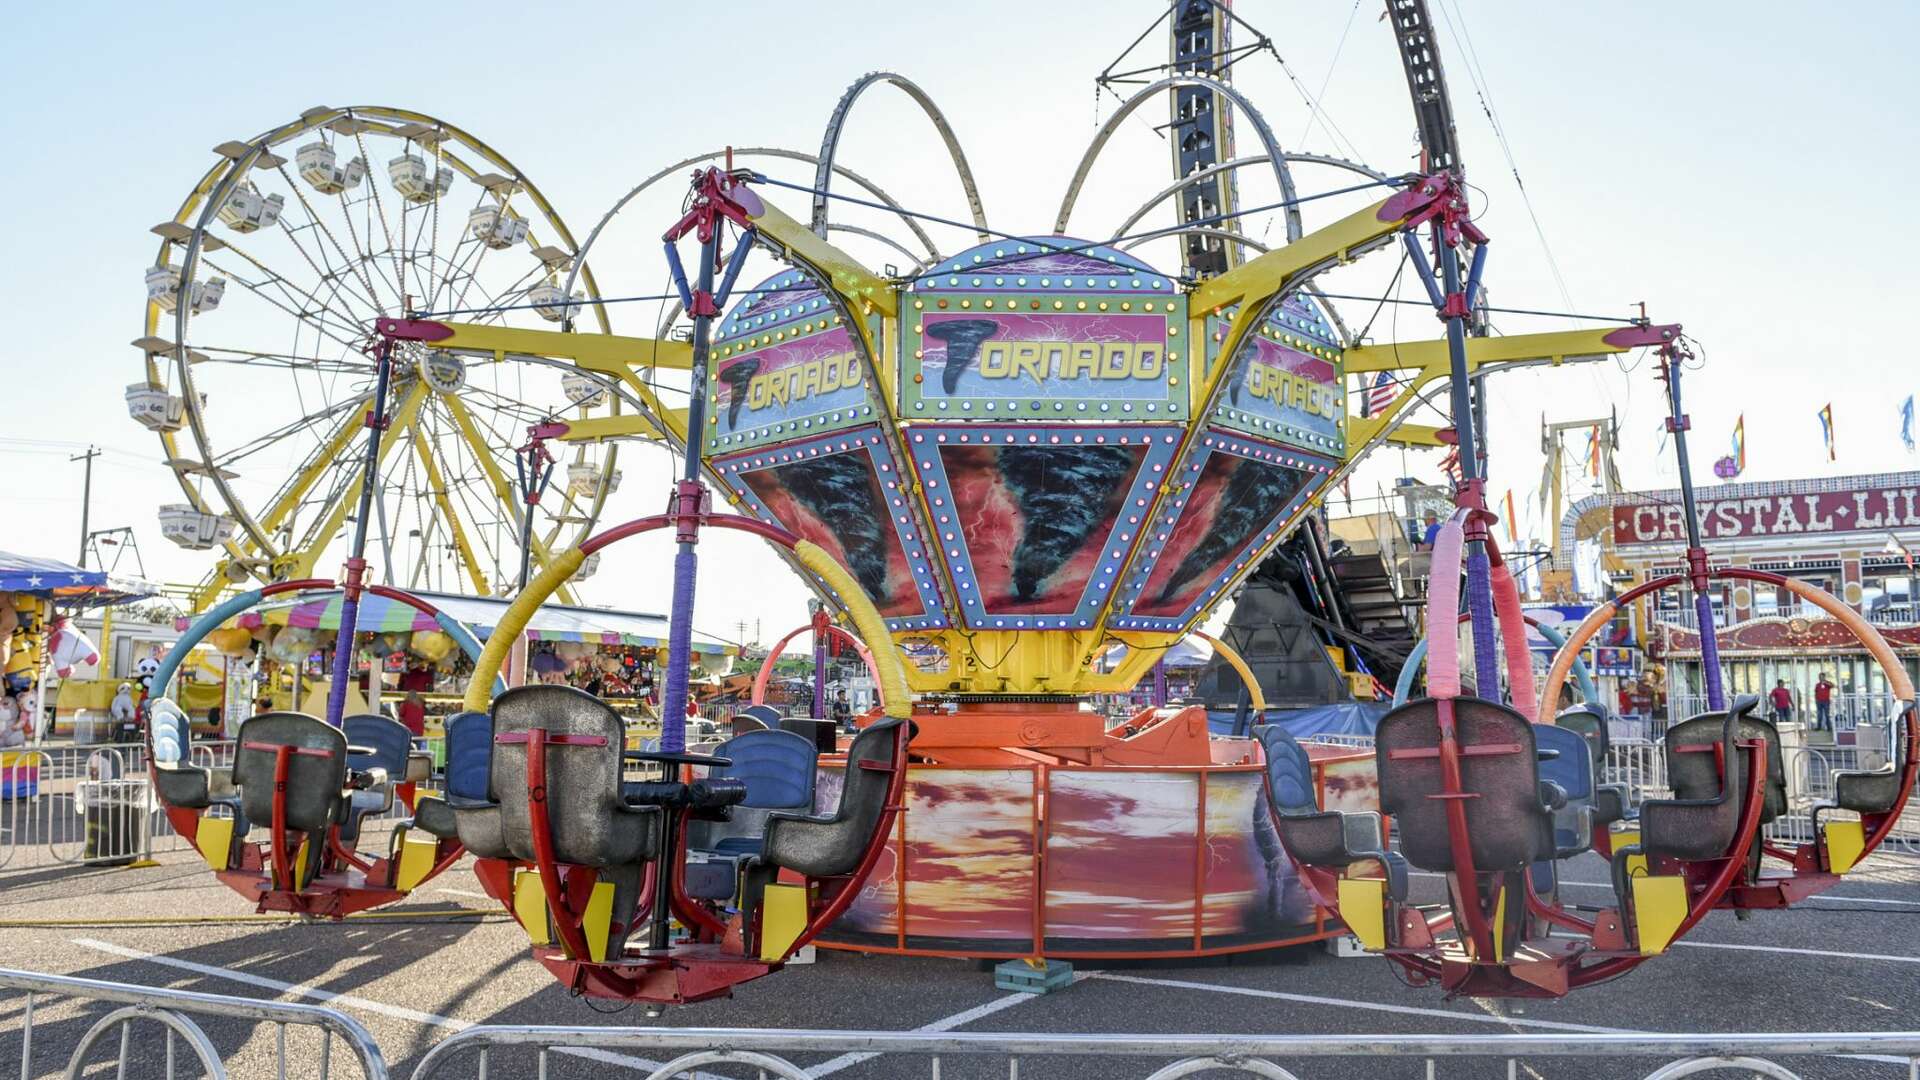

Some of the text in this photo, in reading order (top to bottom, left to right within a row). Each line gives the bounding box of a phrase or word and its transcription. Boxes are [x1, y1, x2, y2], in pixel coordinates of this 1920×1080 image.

[1633, 495, 1834, 542] CRYSTAL
[965, 656, 977, 667] 2
[1081, 655, 1093, 666] 3
